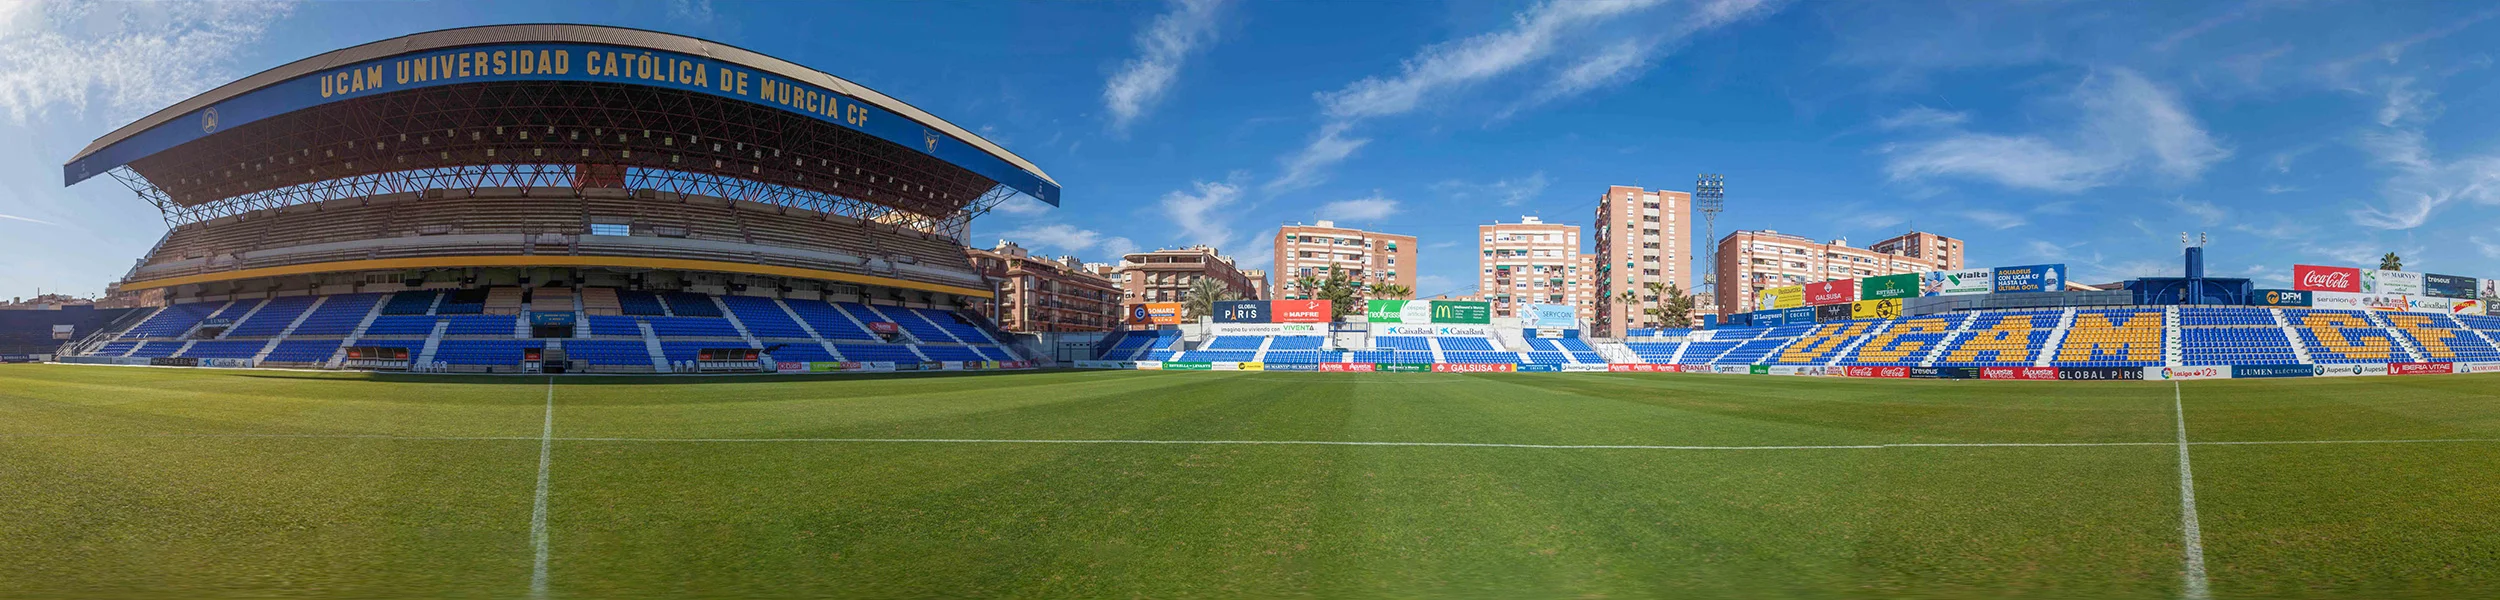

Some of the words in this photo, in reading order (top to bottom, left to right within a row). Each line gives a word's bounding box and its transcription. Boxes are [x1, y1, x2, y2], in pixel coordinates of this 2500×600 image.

[321, 64, 383, 98] UCAM
[396, 50, 569, 85] UNIVERSIDAD
[587, 50, 708, 88] CATÓLICA
[720, 68, 748, 96] DE
[760, 77, 838, 119] MURCIA
[847, 104, 868, 127] CF
[2427, 276, 2450, 284] treseus
[1876, 288, 1904, 296] ESTRELLA
[1815, 293, 1842, 301] GALSUSA
[2281, 293, 2302, 301] DFM
[2418, 300, 2448, 309] CaixaBank
[1398, 327, 1434, 335] CaixaBank
[1450, 327, 1485, 335] CaixaBank
[212, 359, 247, 367] CaixaBk
[1451, 364, 1493, 372] GALSUSA
[1680, 364, 1711, 372] GRANATE
[1984, 367, 2013, 376] Apuestas
[2022, 367, 2053, 376] Apuestas
[2059, 371, 2105, 379] GLOBAL
